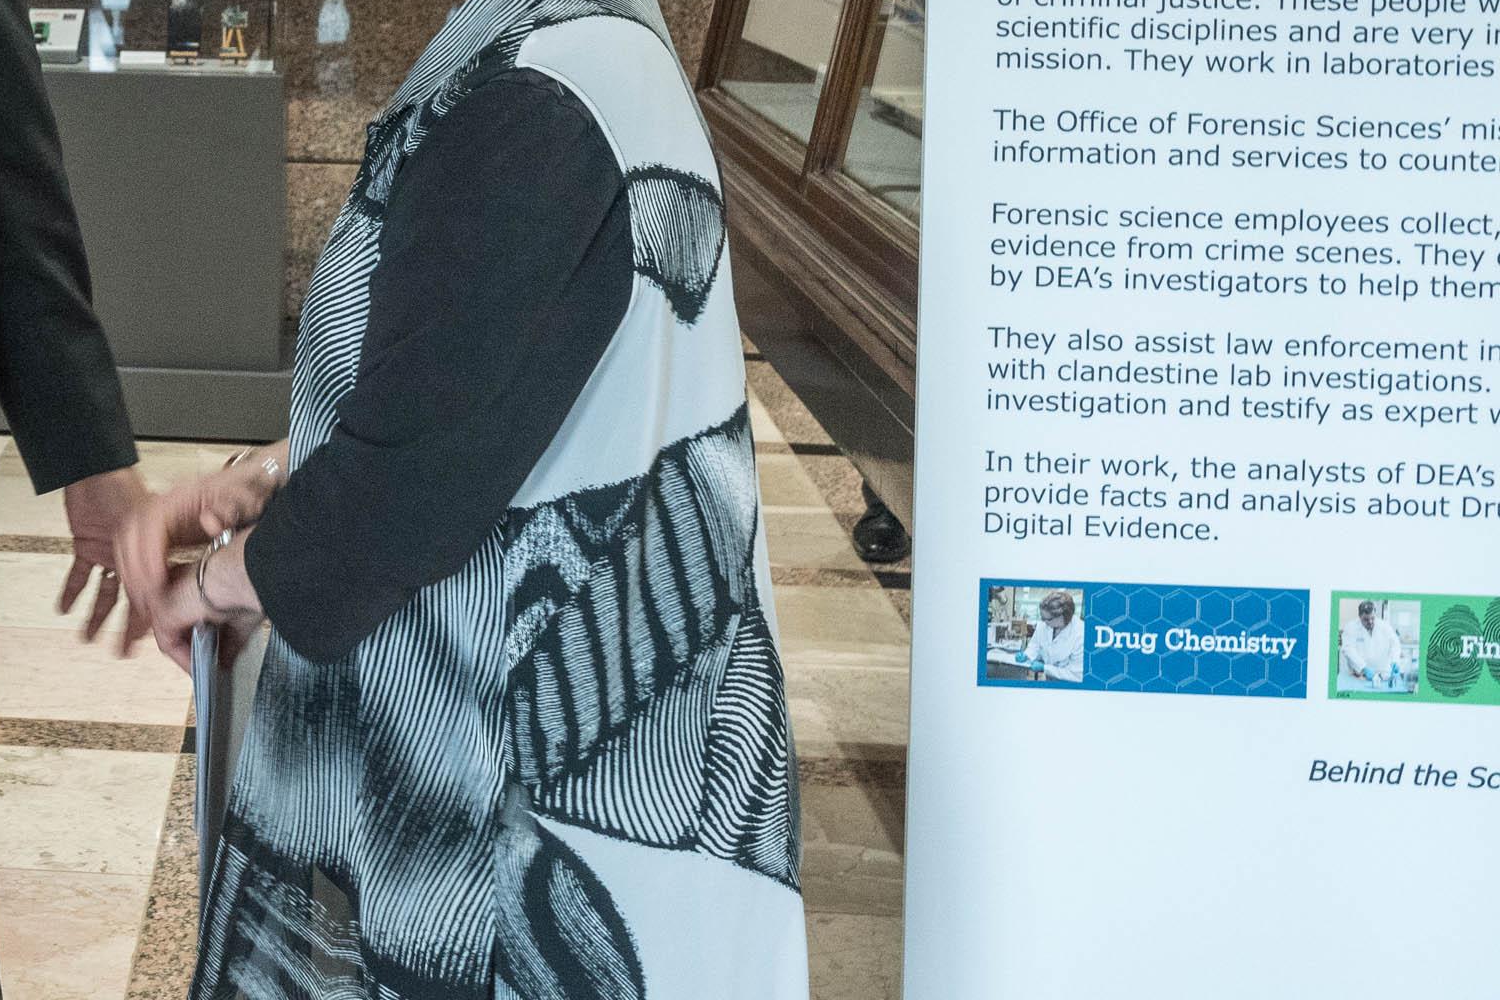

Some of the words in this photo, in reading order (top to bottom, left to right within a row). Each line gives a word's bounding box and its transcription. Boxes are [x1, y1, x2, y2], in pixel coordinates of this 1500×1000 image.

[995, 15, 1121, 40] scientific
[1130, 16, 1278, 47] disciplines
[1288, 19, 1341, 44] and
[1352, 25, 1400, 45] are
[1410, 26, 1474, 51] very
[996, 46, 1111, 71] mission.
[1123, 47, 1194, 78] They
[1205, 49, 1275, 74] work
[1286, 51, 1310, 75] in
[1323, 50, 1495, 78] laboratories
[992, 108, 1046, 132] The
[1056, 109, 1138, 134] Office
[1148, 111, 1178, 135] of
[1187, 112, 1306, 138] Forensic
[1461, 117, 1500, 141] mi
[993, 139, 1156, 166] information
[1167, 143, 1220, 167] and
[1231, 145, 1348, 170] services
[1359, 148, 1388, 171] to
[1398, 150, 1500, 173] counte
[992, 202, 1109, 228] Forensic
[1118, 205, 1224, 230] science
[1234, 208, 1389, 238] employees
[990, 233, 1116, 259] evidence
[1126, 235, 1193, 261] from
[1204, 239, 1285, 263] crime
[1295, 245, 1401, 265] scenes.
[1413, 242, 1486, 273] They
[990, 263, 1024, 293] by
[1124, 267, 1308, 298] investigators
[1318, 273, 1347, 296] to
[1359, 272, 1419, 303] help
[986, 325, 1057, 356] They
[1067, 327, 1124, 352] also
[1134, 331, 1216, 355] assist
[1226, 331, 1274, 356] law
[1284, 334, 1469, 362] enforcement
[987, 357, 1046, 381] with
[1057, 359, 1219, 386] clandestine
[1230, 362, 1272, 388] lab
[1283, 365, 1491, 396] investigations.
[987, 388, 1167, 419] investigation
[1178, 394, 1230, 418] and
[1241, 396, 1331, 426] testify
[1341, 403, 1374, 422] as
[1384, 402, 1479, 429] expert
[985, 449, 1013, 473] In
[1024, 450, 1091, 475] their
[1100, 454, 1178, 483] work,
[1190, 455, 1237, 480] the
[1247, 458, 1366, 488] analysts
[1376, 461, 1407, 485] of
[984, 482, 1089, 509] provide
[1099, 483, 1167, 509] facts
[1177, 487, 1230, 511] and
[1241, 489, 1356, 519] analysis
[1367, 492, 1451, 518] about
[1461, 495, 1500, 519] Dr
[984, 511, 1072, 541] Digital
[1084, 515, 1219, 541] Evidence.
[1094, 626, 1158, 654] Drug
[1164, 628, 1297, 659] Chemistry
[1308, 759, 1406, 786] Behind
[1413, 763, 1459, 788] the
